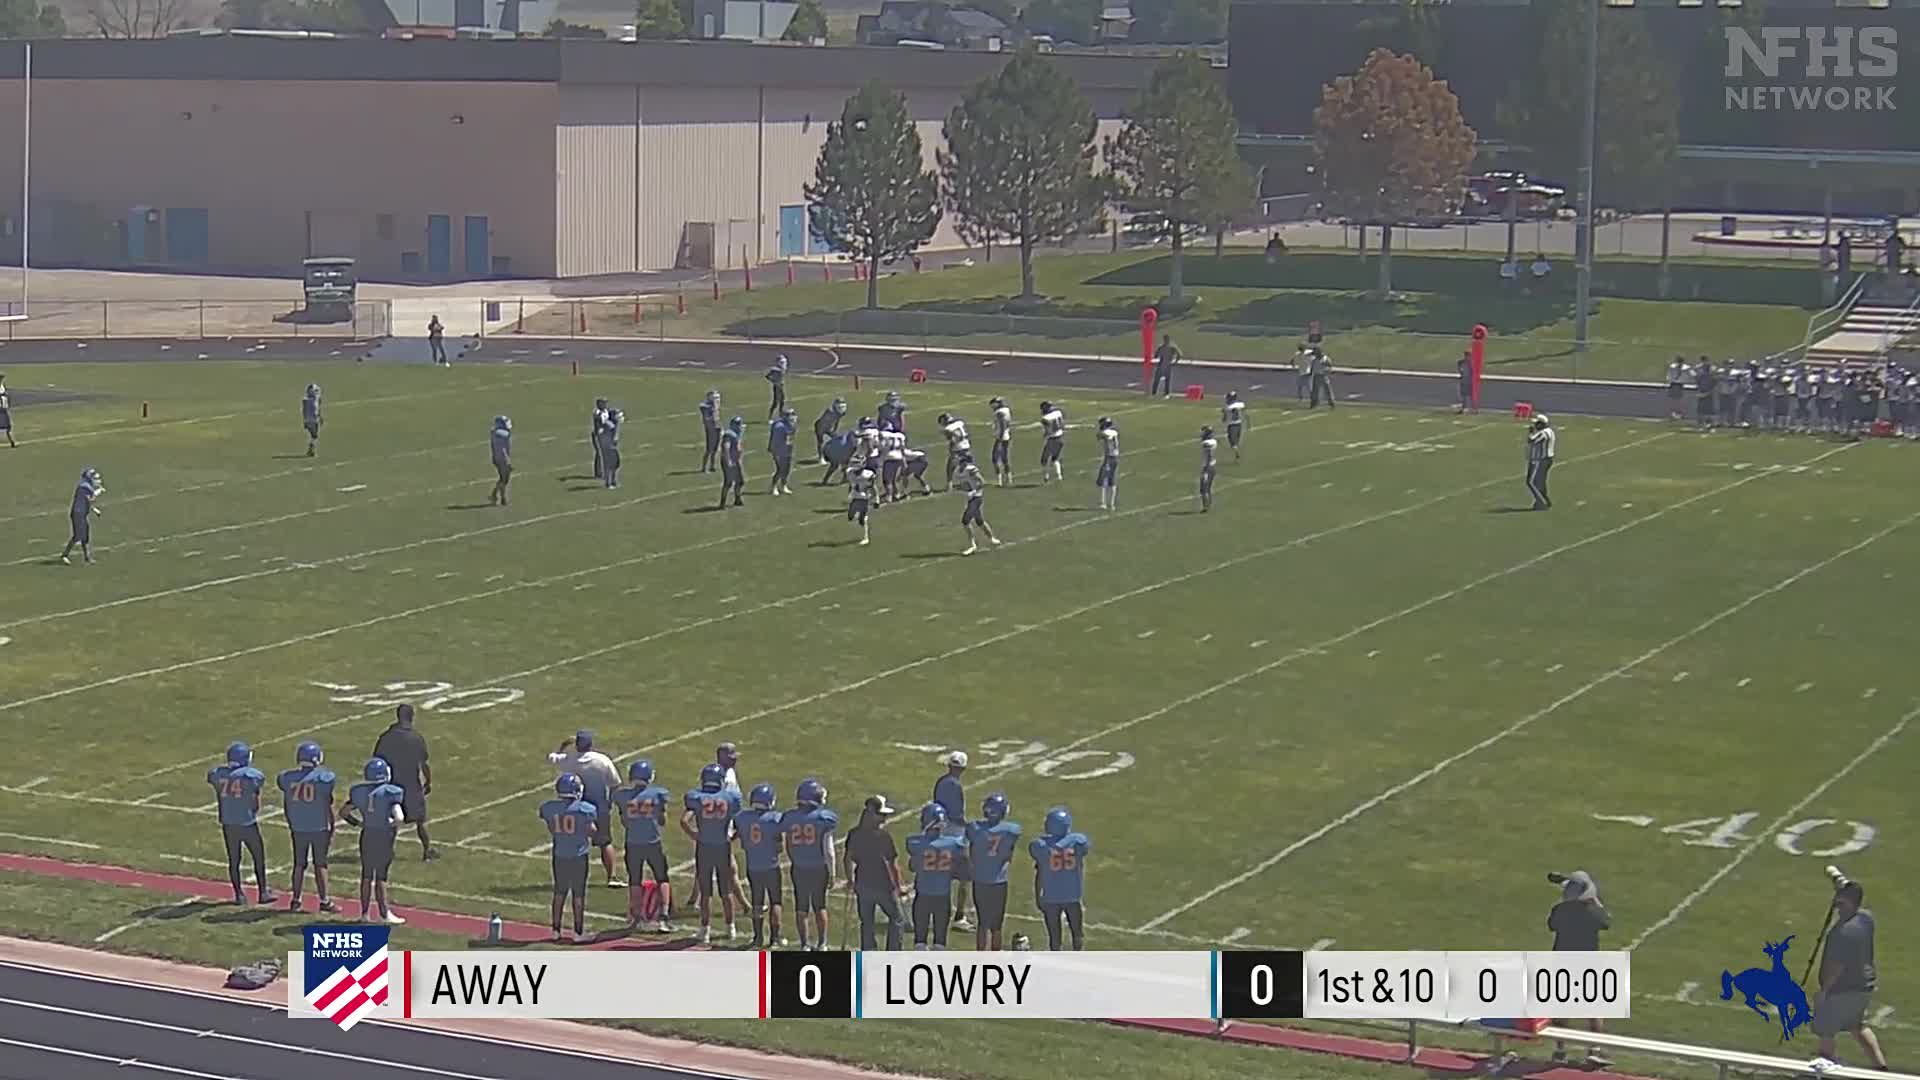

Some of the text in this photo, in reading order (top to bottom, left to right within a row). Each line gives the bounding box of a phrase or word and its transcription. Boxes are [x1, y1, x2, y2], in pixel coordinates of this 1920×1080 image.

[219, 778, 243, 798] 74
[290, 783, 315, 802] 70
[552, 813, 576, 834] 10
[751, 823, 763, 844] 6
[791, 823, 817, 845] 29
[1661, 811, 1876, 857] 40
[986, 835, 1001, 857] 7
[923, 848, 952, 872] 22
